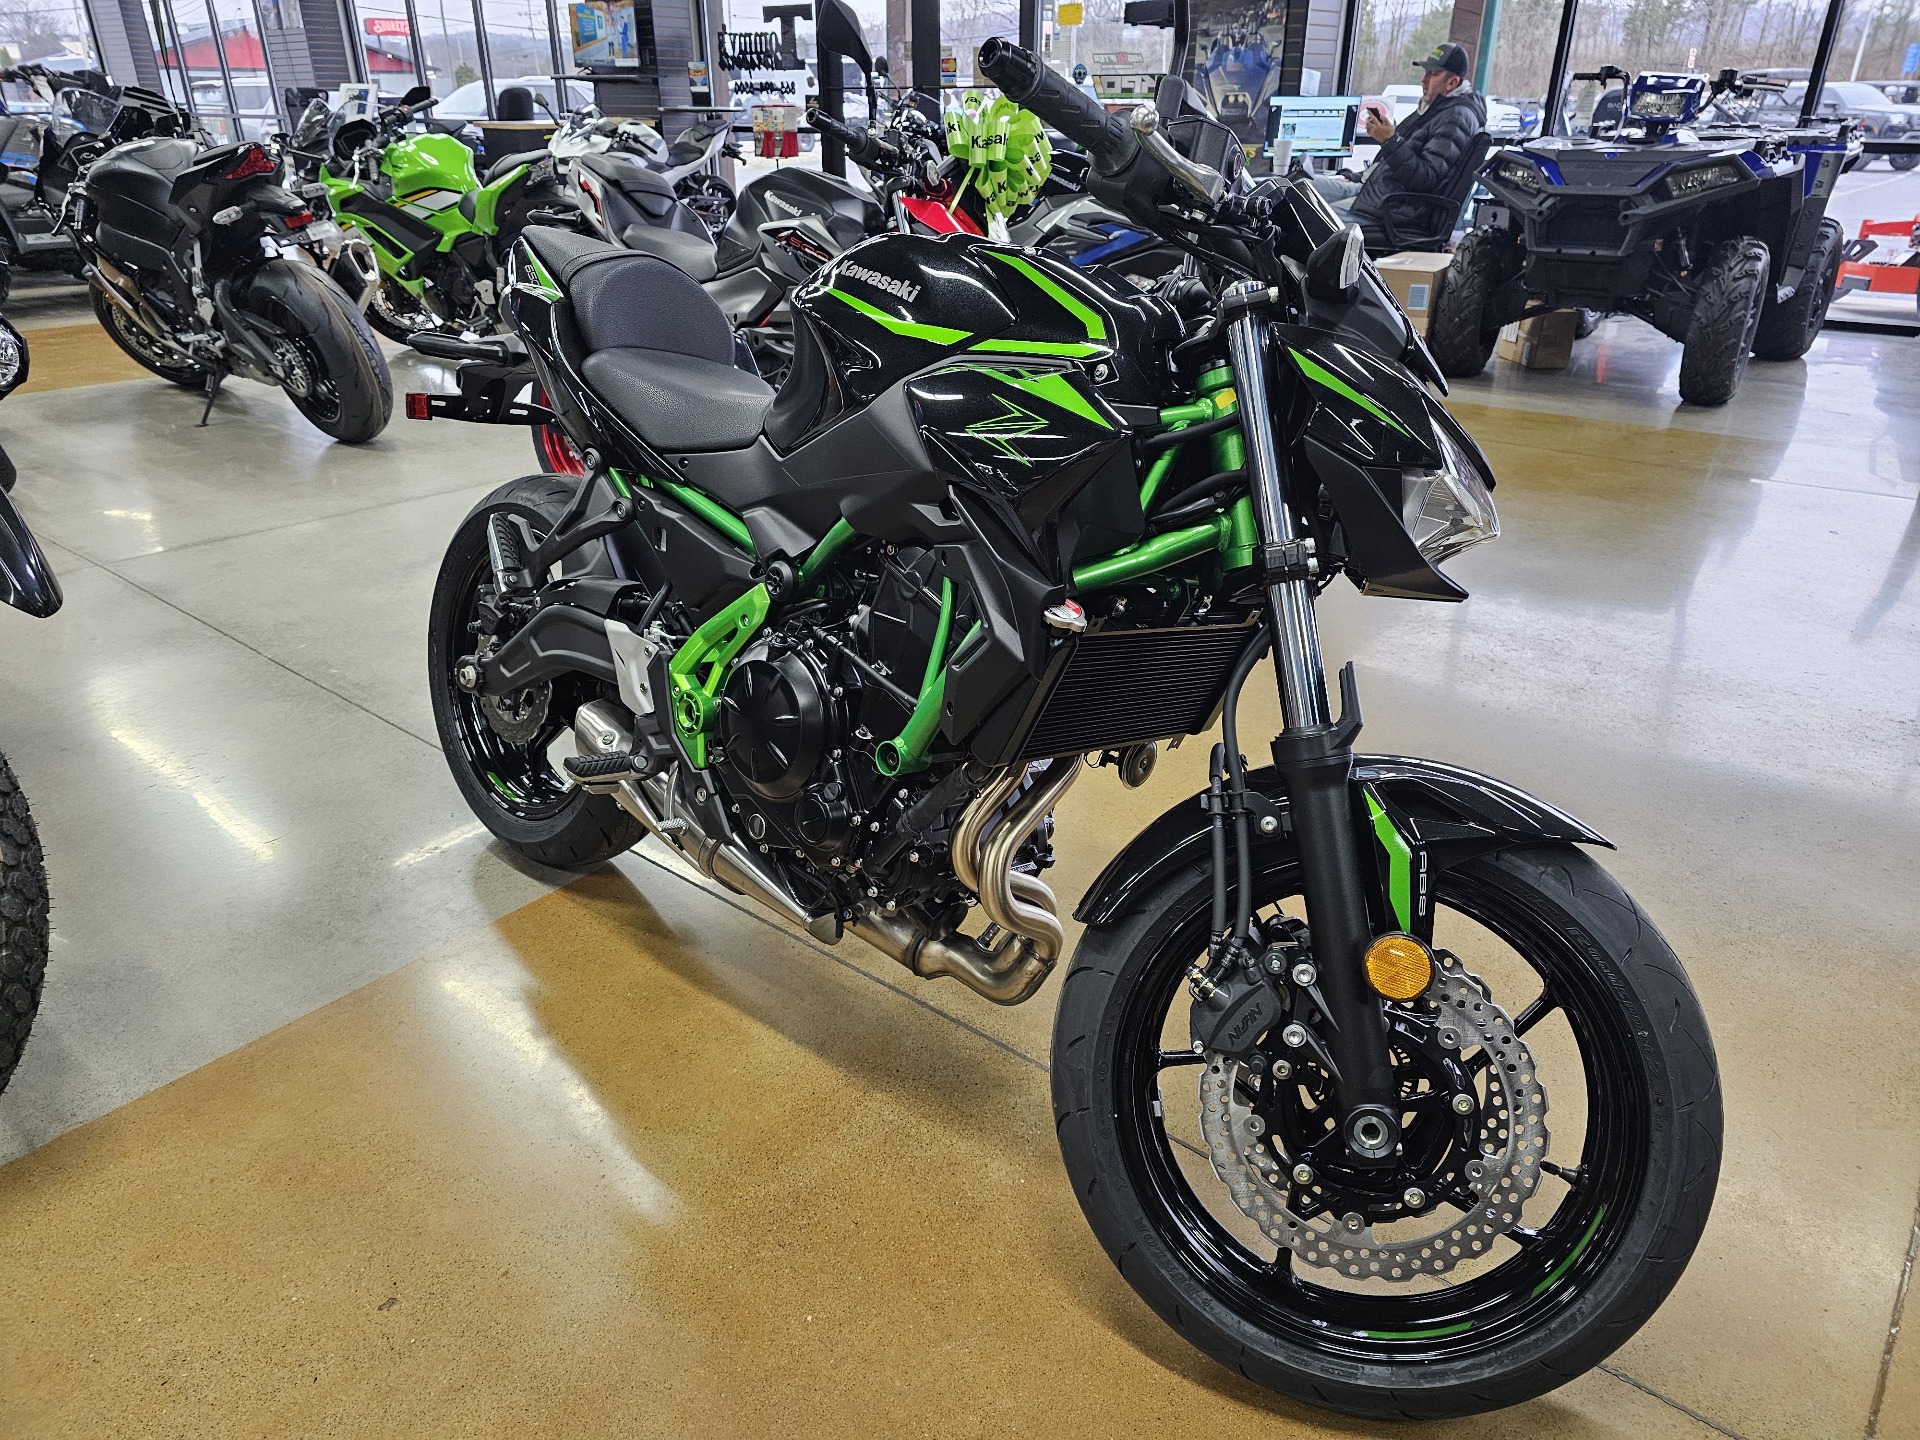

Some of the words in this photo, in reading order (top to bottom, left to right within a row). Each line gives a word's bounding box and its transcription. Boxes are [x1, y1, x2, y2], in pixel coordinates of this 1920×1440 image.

[764, 190, 802, 217] Kawasaki
[836, 259, 922, 303] Kawasaki
[1419, 851, 1428, 917] ABS
